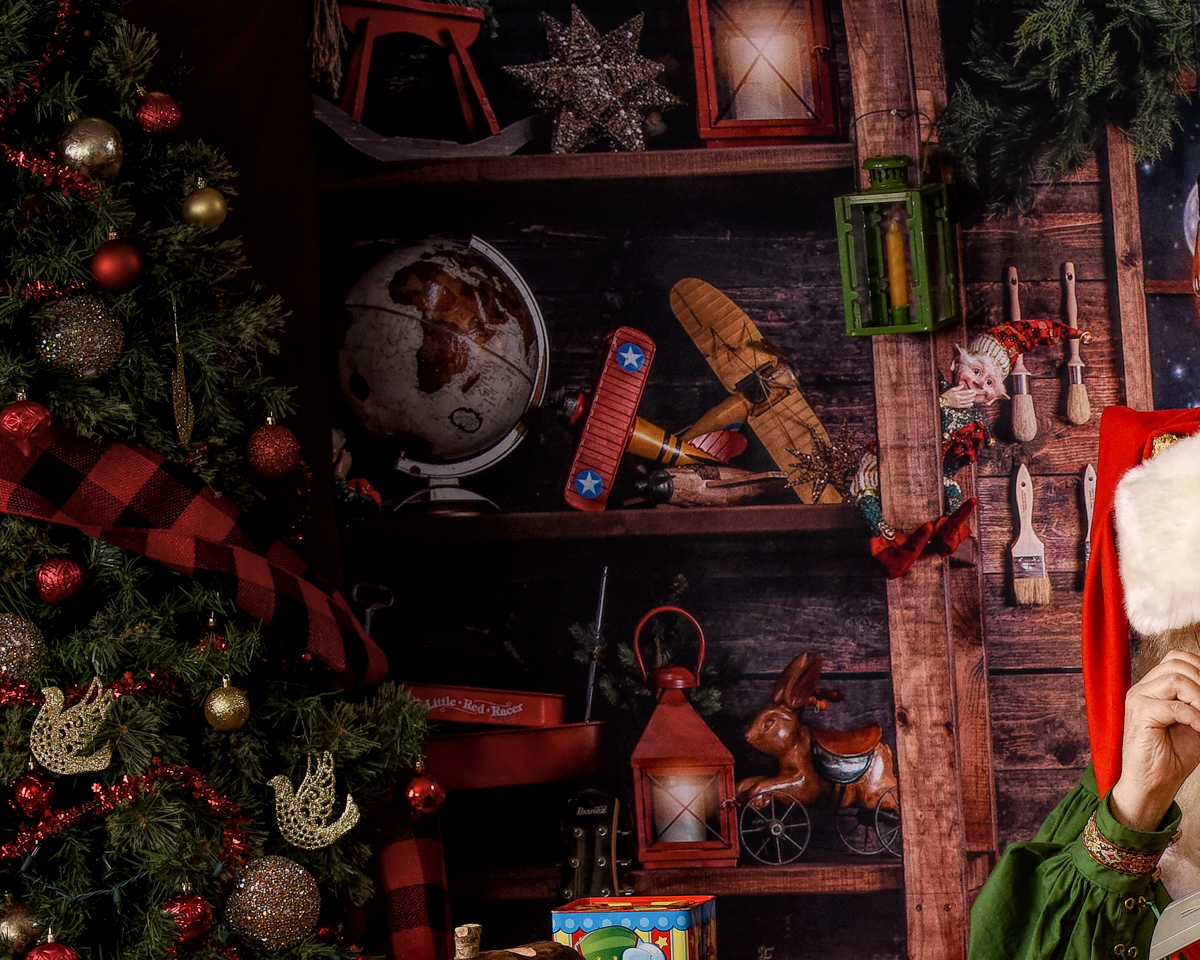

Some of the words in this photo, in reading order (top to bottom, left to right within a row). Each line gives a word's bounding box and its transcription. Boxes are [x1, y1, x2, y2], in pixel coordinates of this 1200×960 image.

[426, 696, 456, 710] Little
[463, 698, 485, 714] Red
[490, 703, 523, 717] Racer
[576, 805, 608, 815] Ibanez
